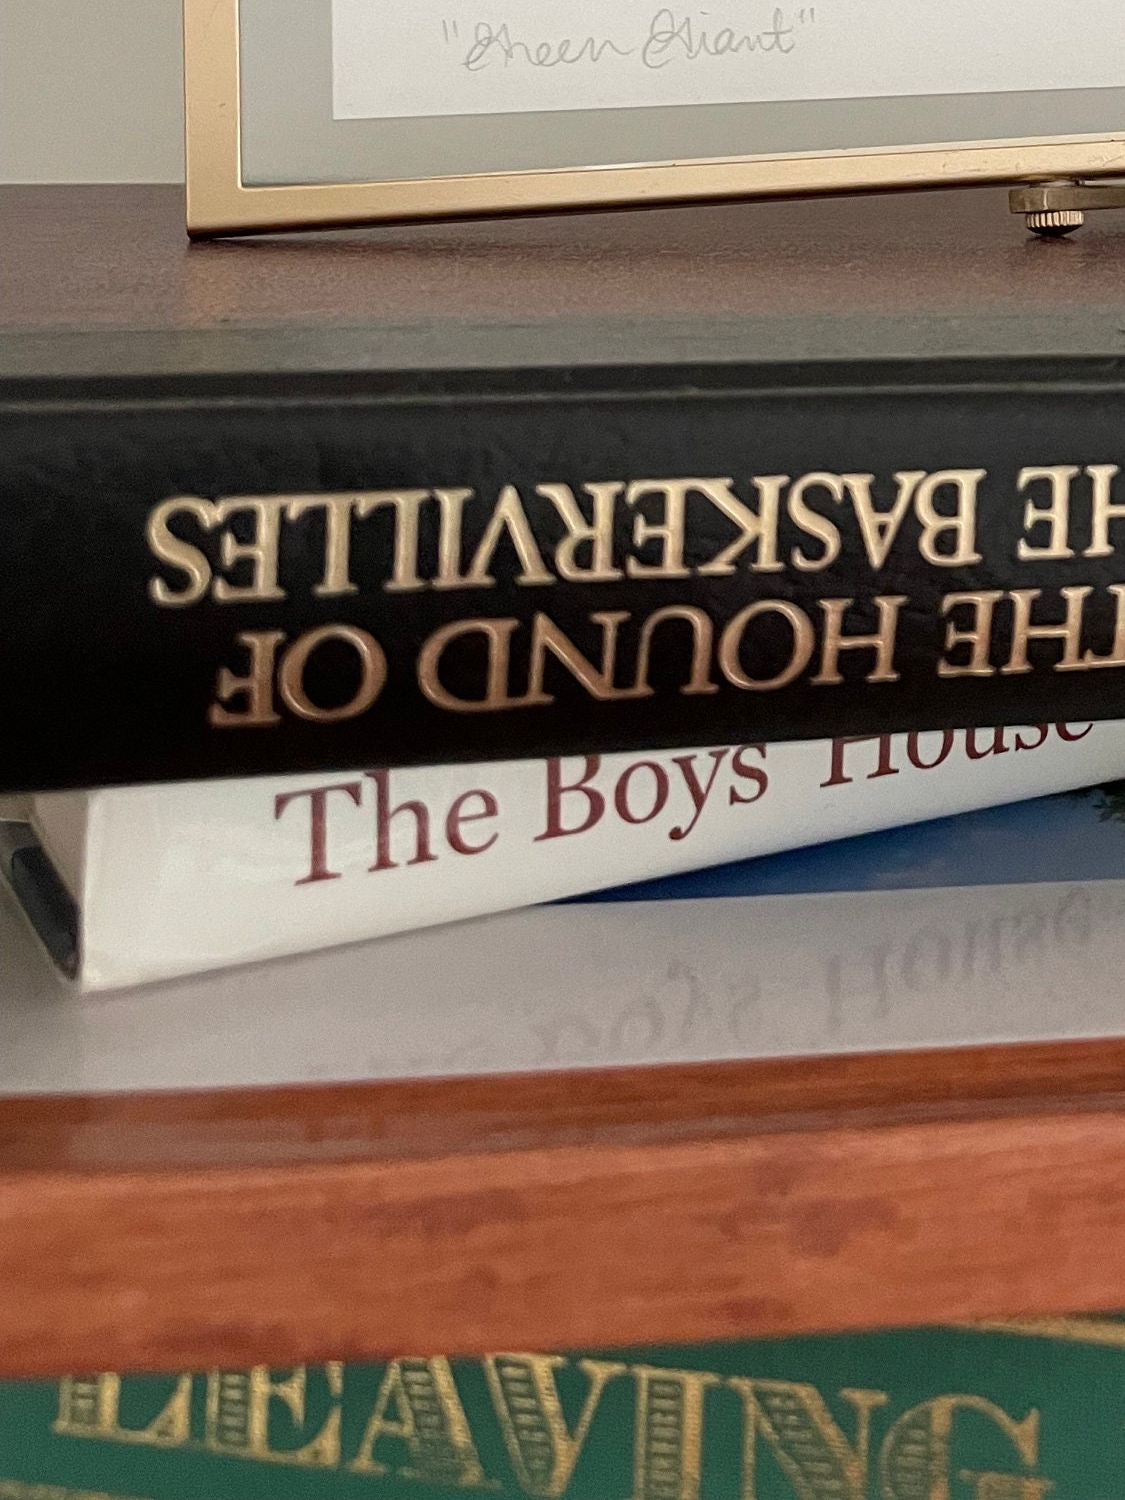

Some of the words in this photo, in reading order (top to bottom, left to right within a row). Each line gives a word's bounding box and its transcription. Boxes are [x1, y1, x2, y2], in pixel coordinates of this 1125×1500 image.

[146, 468, 987, 606] BASKERVILLES
[209, 623, 388, 728] OF
[417, 596, 907, 713] HOUND
[274, 768, 499, 886] The
[533, 744, 769, 842] Boys
